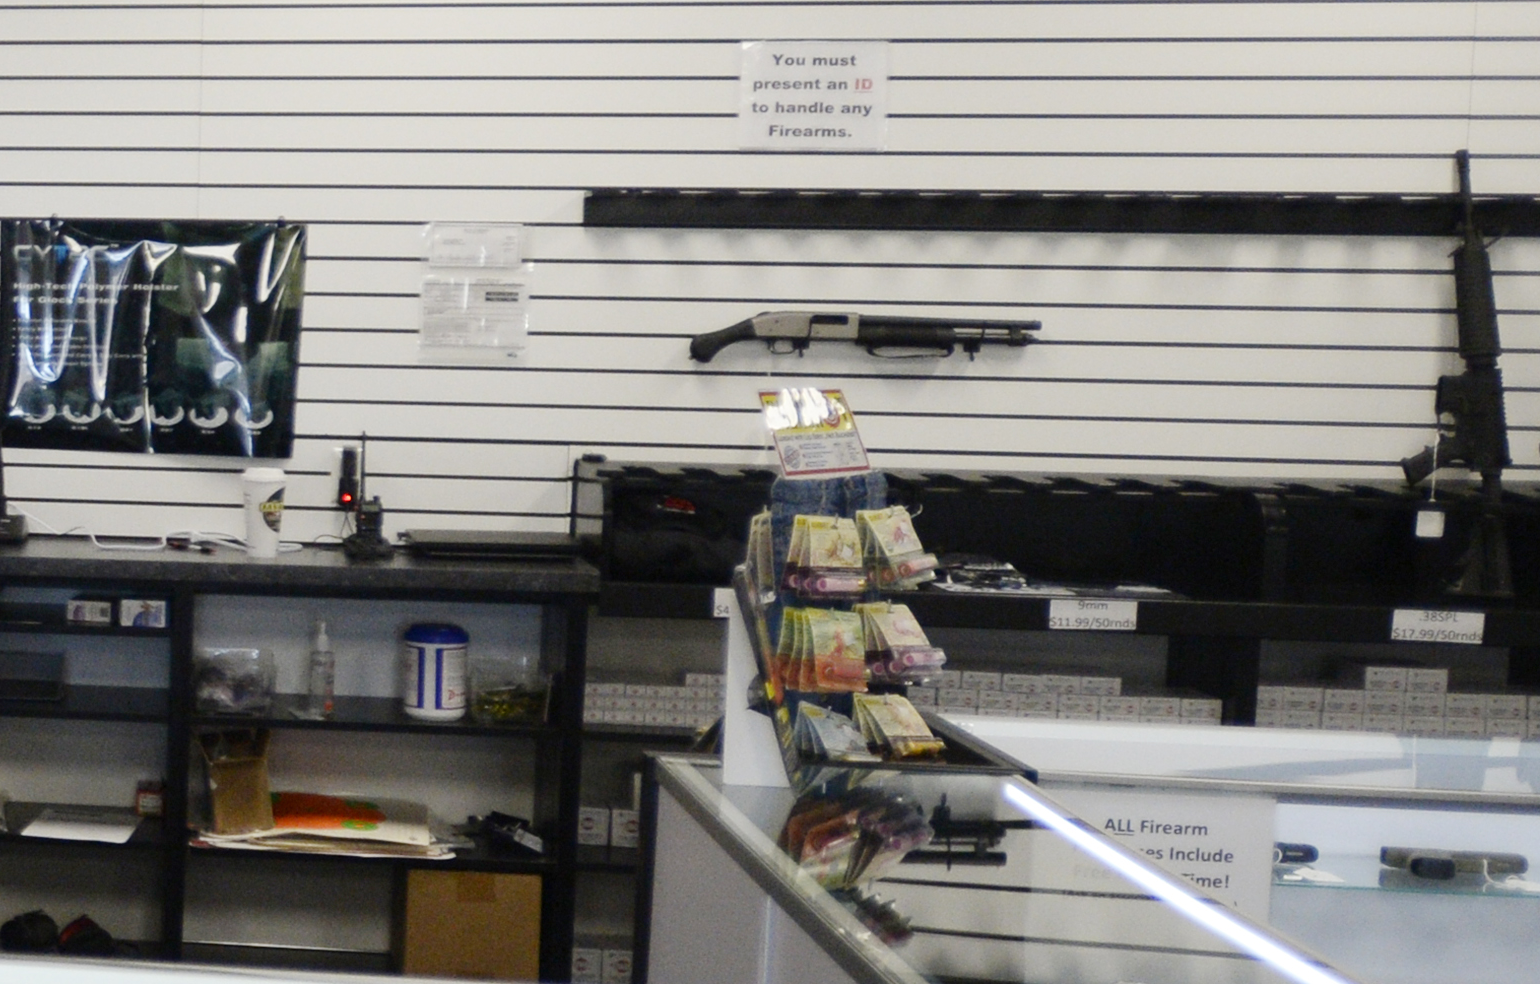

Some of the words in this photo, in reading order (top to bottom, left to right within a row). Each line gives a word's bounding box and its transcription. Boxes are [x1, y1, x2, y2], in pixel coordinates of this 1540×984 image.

[772, 54, 806, 66] You
[812, 55, 857, 66] must
[753, 79, 821, 92] present
[827, 80, 848, 90] an
[854, 78, 873, 91] ID
[752, 103, 769, 114] to
[775, 102, 835, 114] handle
[840, 103, 872, 116] any
[769, 125, 852, 138] Firearms.
[1078, 601, 1109, 610] 9mm
[1104, 818, 1134, 833] ALL
[1140, 819, 1208, 836] Firearm
[1169, 847, 1234, 863] Include
